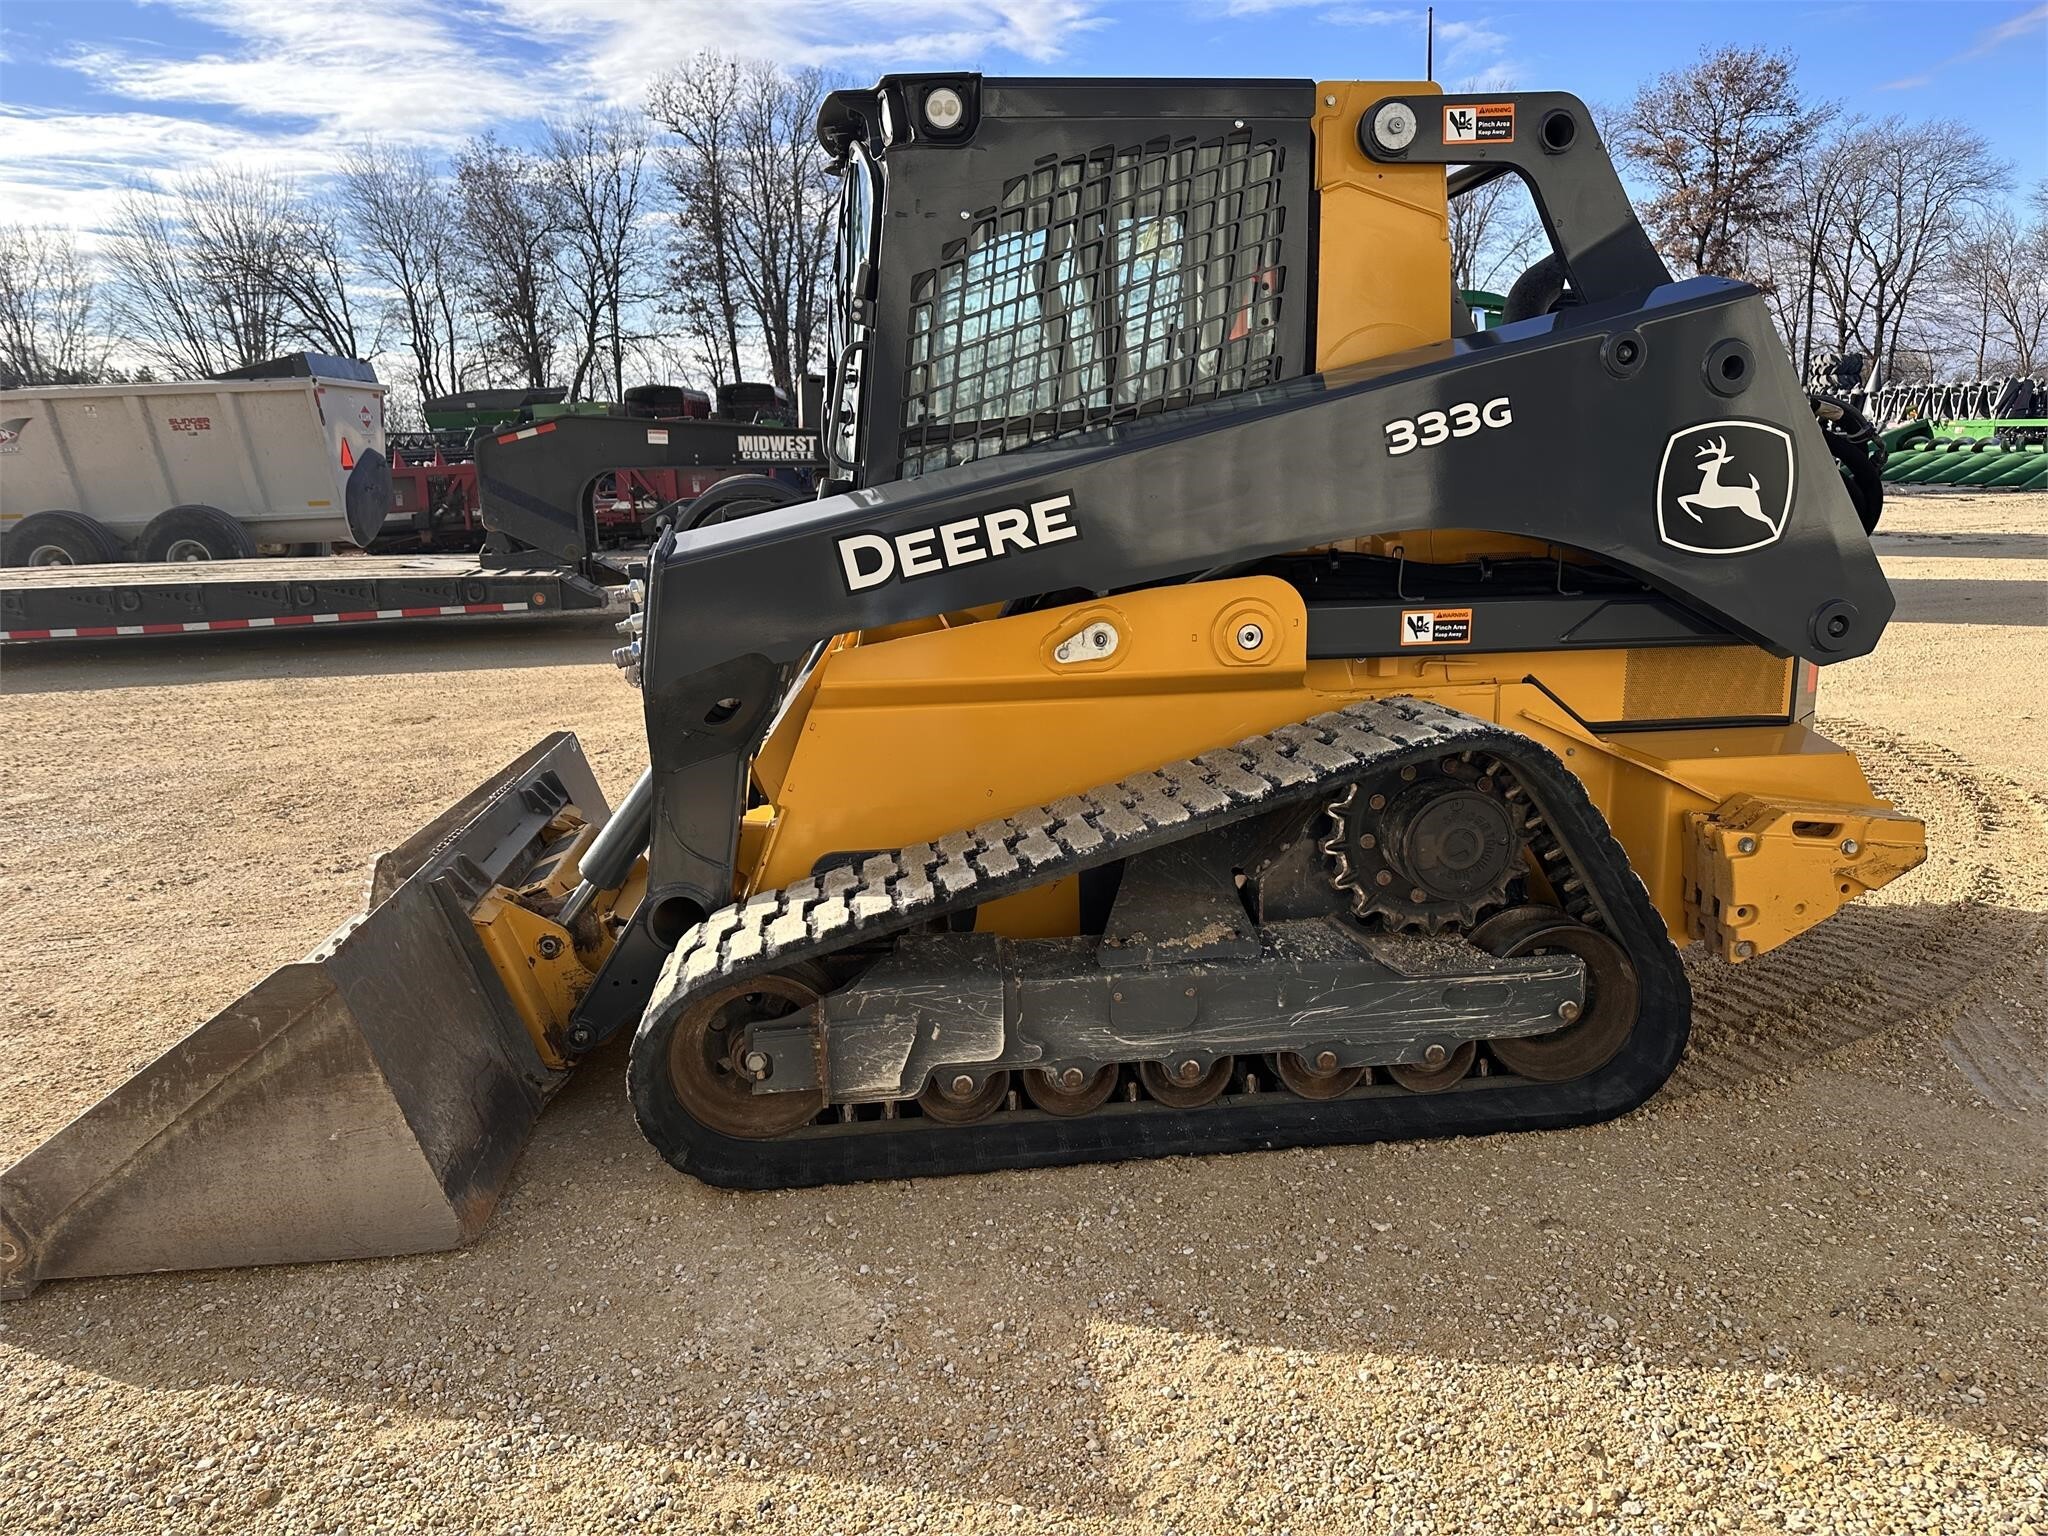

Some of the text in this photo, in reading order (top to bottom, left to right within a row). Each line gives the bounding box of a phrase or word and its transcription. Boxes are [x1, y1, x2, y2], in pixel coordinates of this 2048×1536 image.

[1485, 106, 1512, 114] WARNING
[1385, 397, 1513, 455] 333G
[737, 435, 818, 452] MIDWEST
[742, 451, 815, 460] CONCRETE
[838, 495, 1077, 591] DEERE
